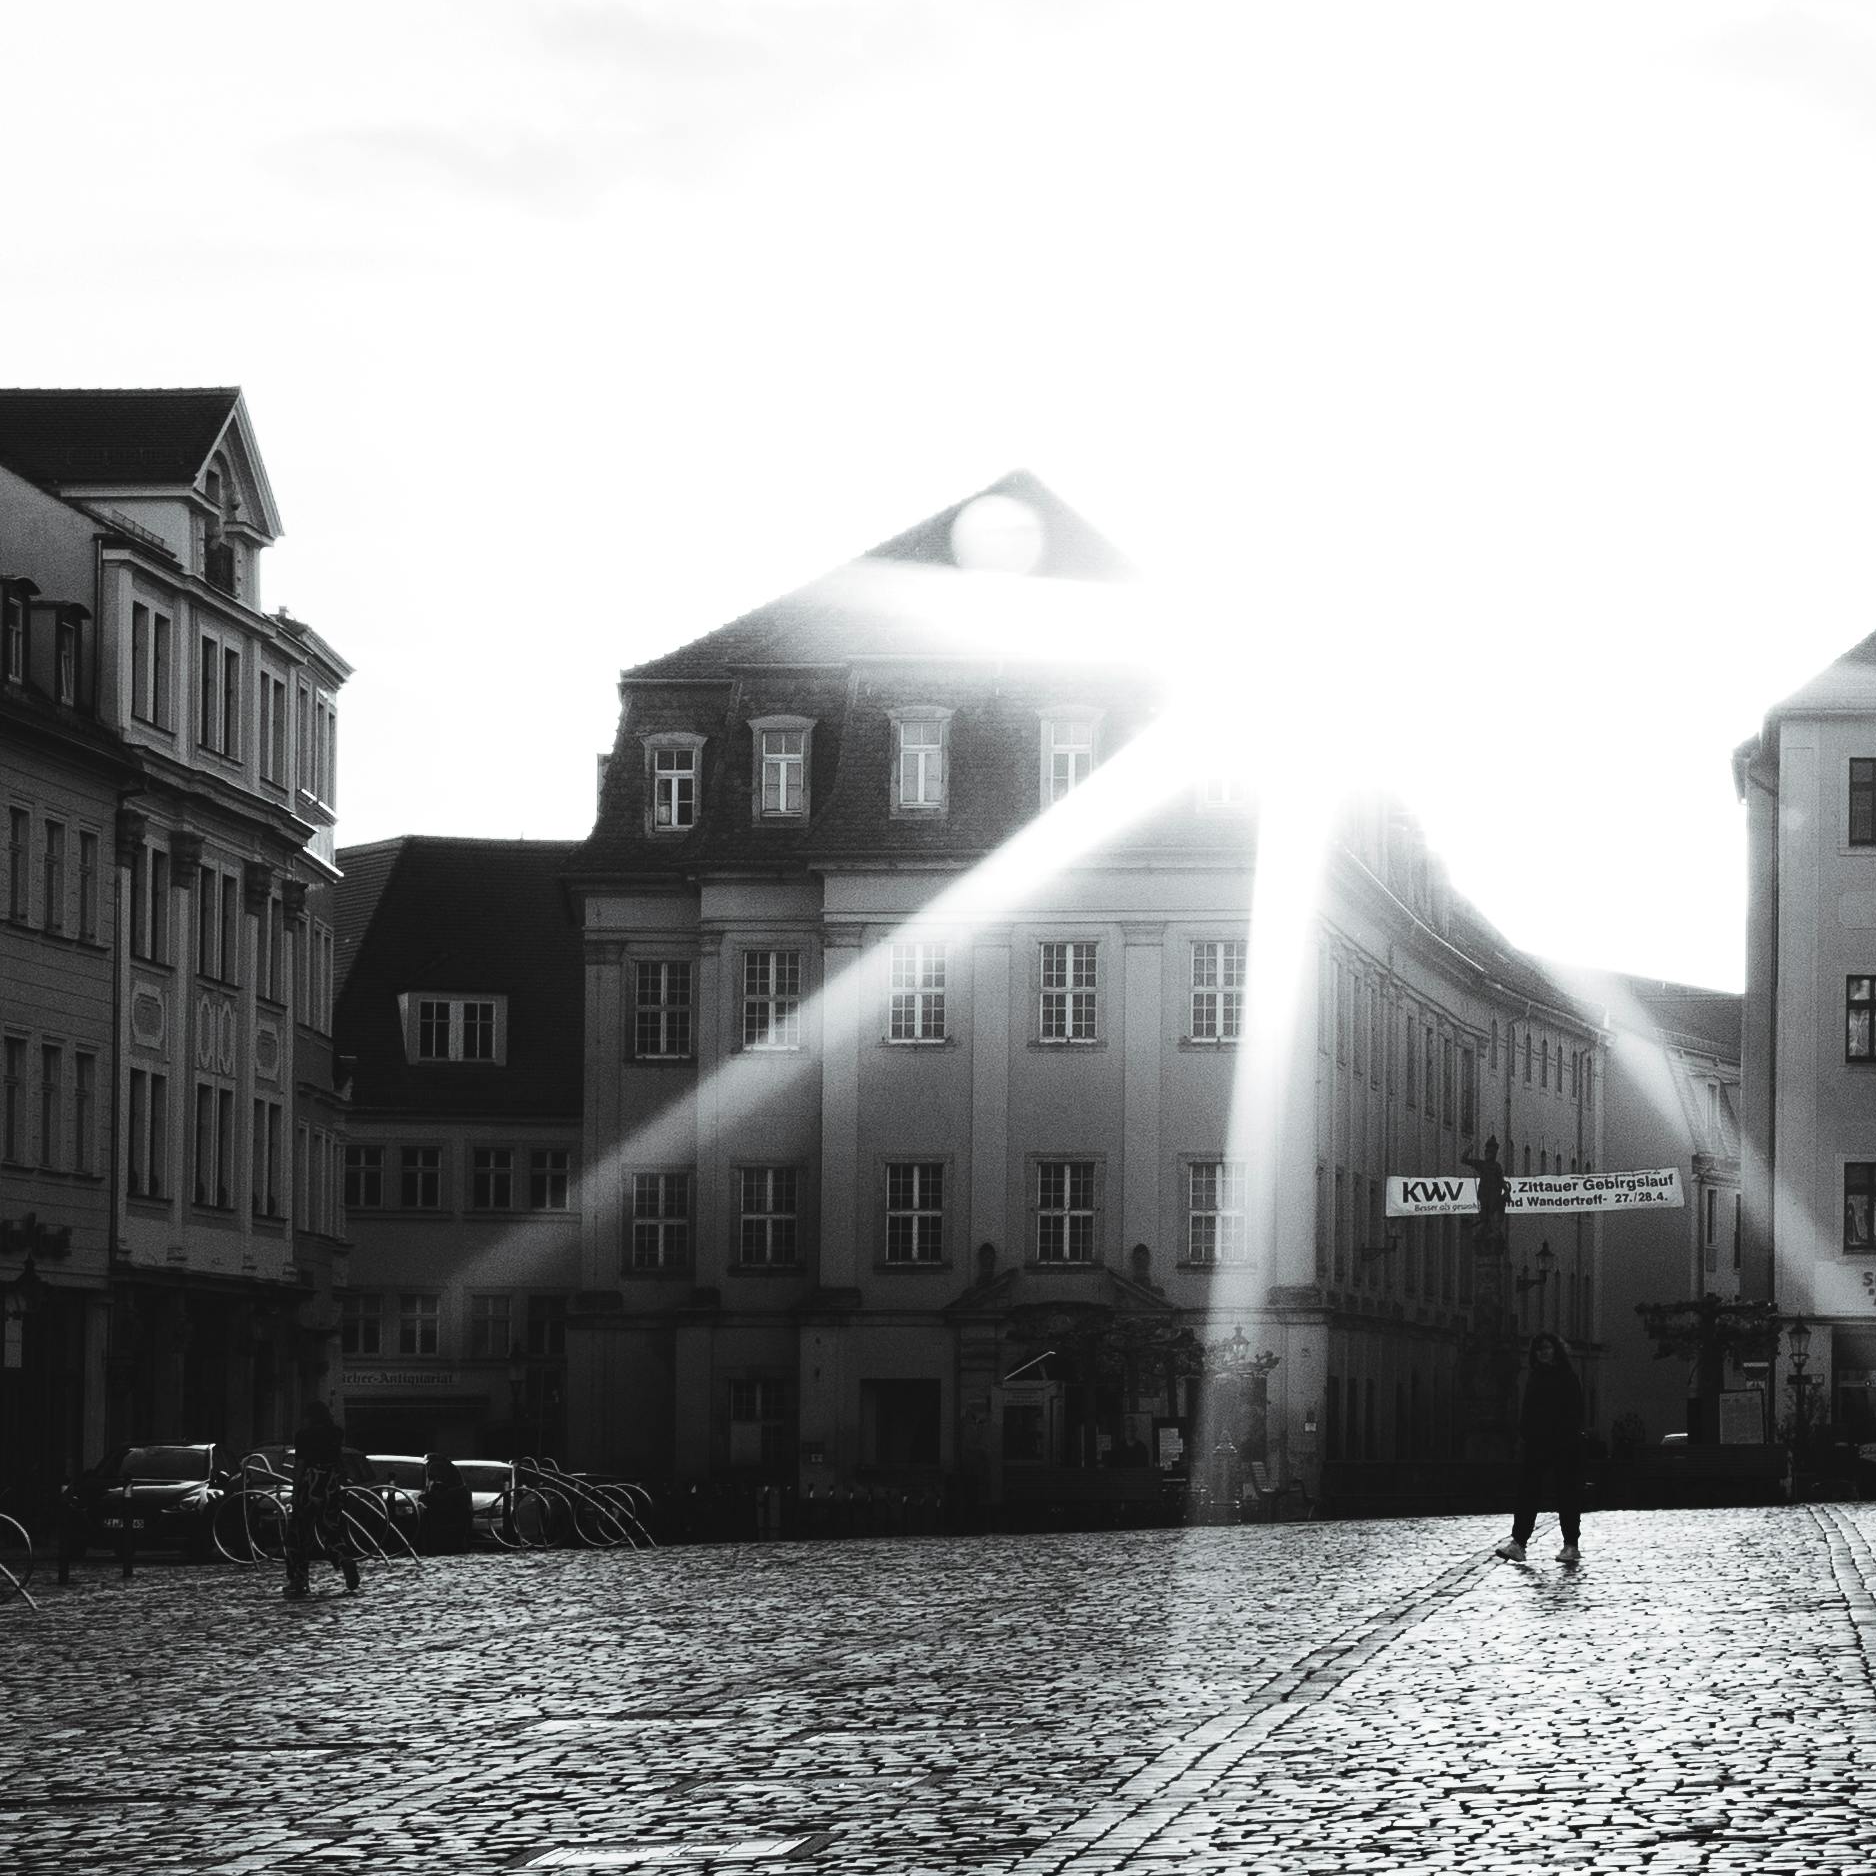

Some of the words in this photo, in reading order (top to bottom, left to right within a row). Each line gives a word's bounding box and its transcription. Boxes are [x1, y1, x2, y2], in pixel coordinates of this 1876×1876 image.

[1402, 1181, 1464, 1203] KWV
[1518, 1181, 1579, 1194] Zittauer
[1583, 1174, 1674, 1192] Gebirgslauf
[1505, 1197, 1523, 1208] nd
[1527, 1193, 1608, 1207] Wandertreff-
[342, 1372, 453, 1386] cher-Antiquariat
